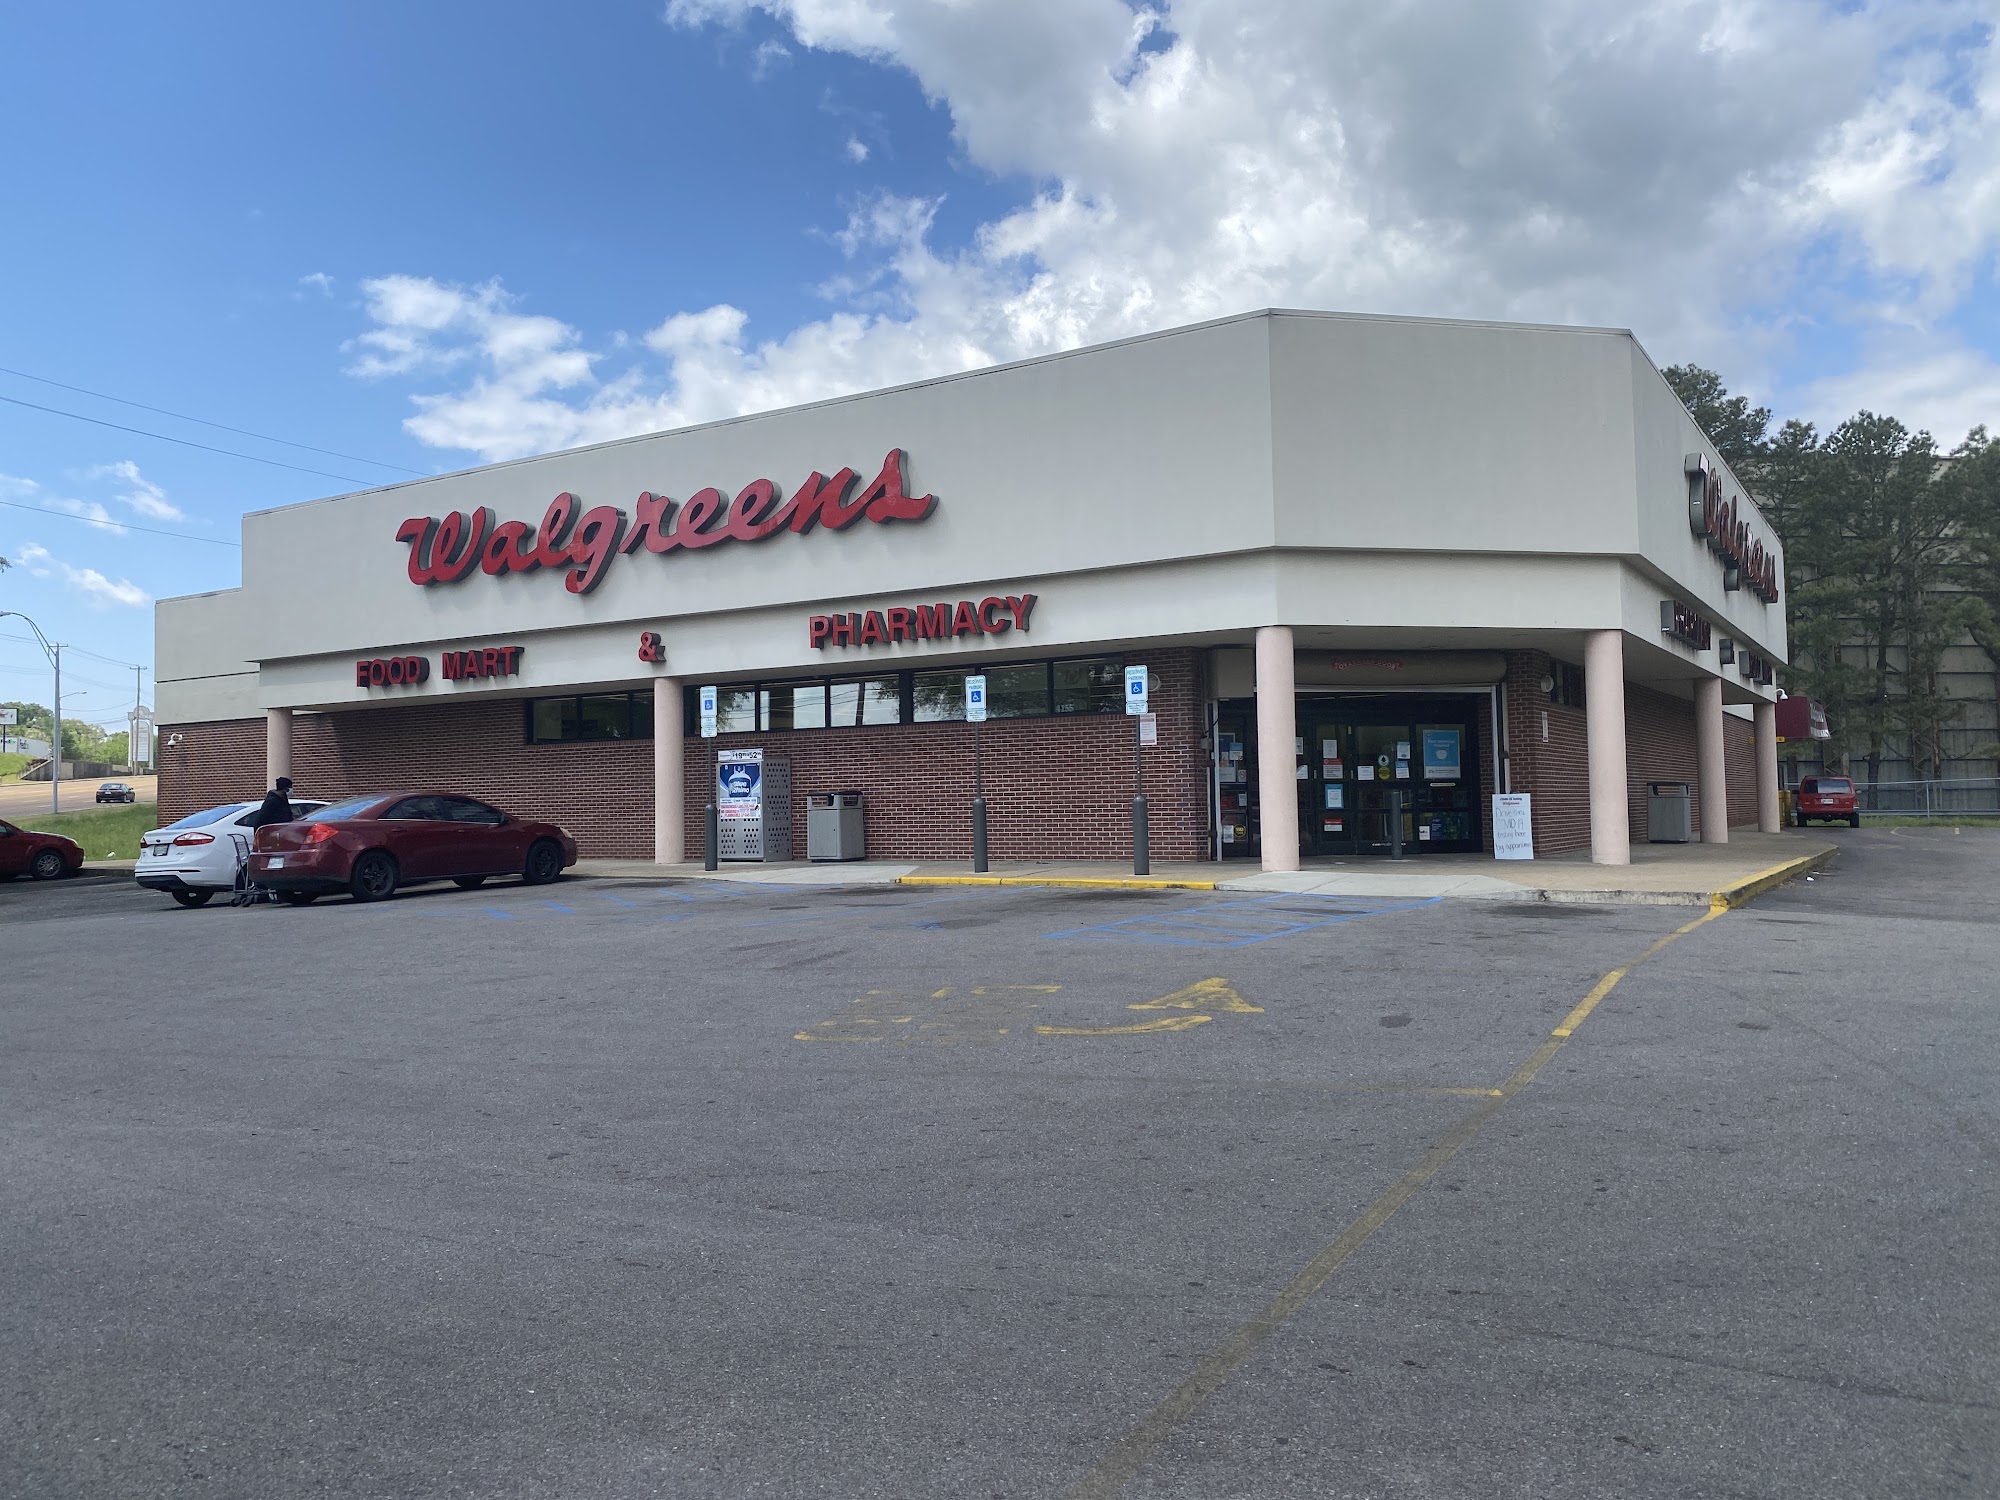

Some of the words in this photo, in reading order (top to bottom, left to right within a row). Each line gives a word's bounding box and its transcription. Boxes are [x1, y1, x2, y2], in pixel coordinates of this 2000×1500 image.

[396, 448, 938, 594] Walgreens
[809, 594, 1037, 649] PHARMACY
[356, 656, 426, 687] FOOD
[442, 646, 520, 680] MART
[638, 631, 663, 662] &
